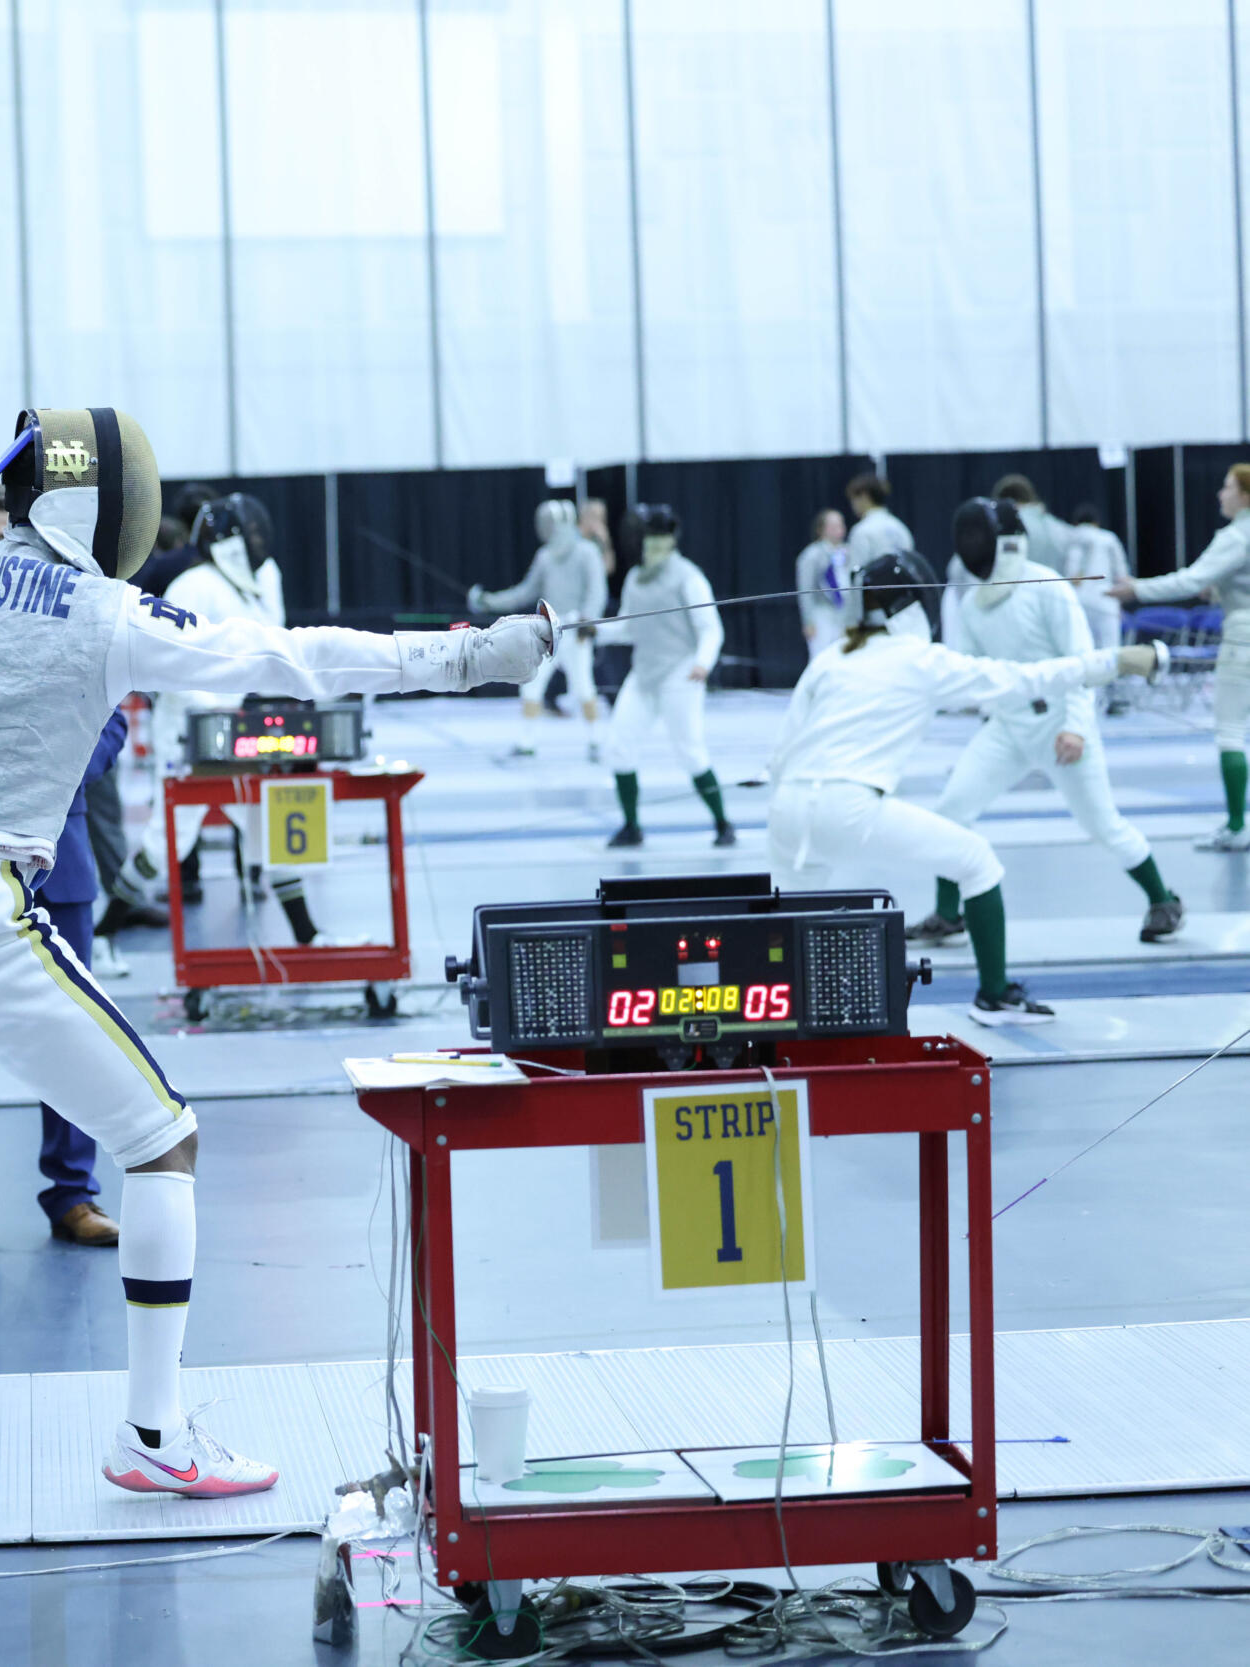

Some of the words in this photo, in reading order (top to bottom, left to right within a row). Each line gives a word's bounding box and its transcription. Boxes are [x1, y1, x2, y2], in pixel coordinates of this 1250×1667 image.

[285, 811, 307, 856] 6
[607, 989, 656, 1025] 02
[660, 986, 740, 1014] 02:08
[743, 984, 791, 1020] 05
[675, 1101, 775, 1141] STRIP
[713, 1160, 743, 1263] 1
